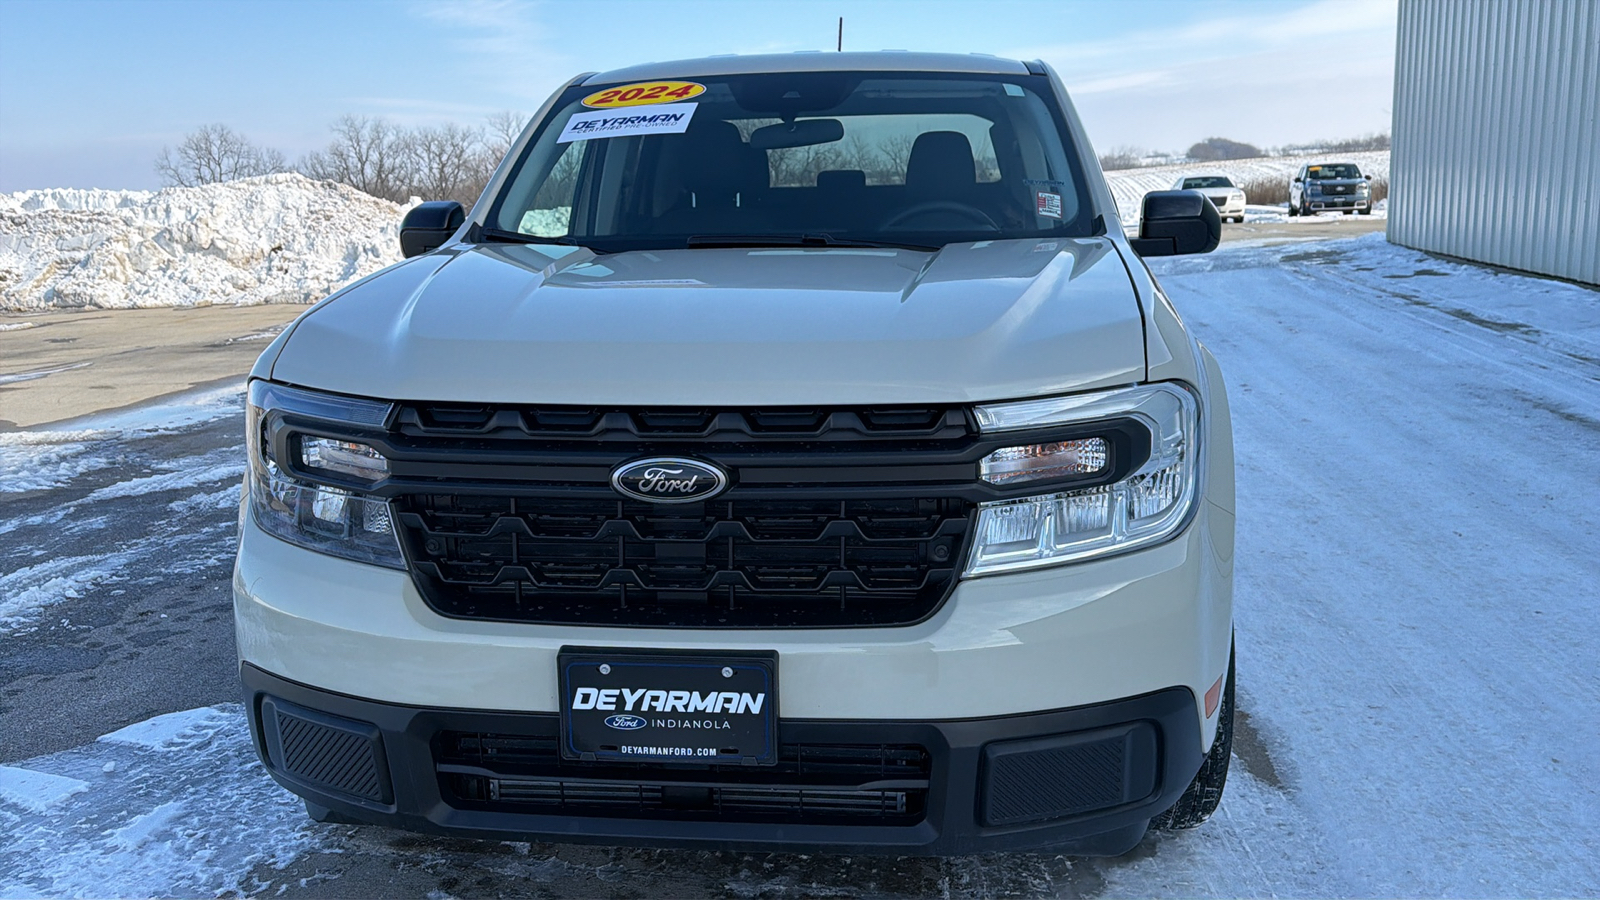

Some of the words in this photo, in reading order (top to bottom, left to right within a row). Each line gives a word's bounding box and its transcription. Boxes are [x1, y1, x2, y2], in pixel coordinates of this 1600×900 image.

[591, 84, 696, 105] 2024
[571, 113, 686, 131] DEYARMAN
[576, 125, 622, 134] CERTIFIED
[624, 121, 678, 129] PRE-OWNED
[638, 467, 698, 493] Ford
[572, 687, 765, 714] DEYARMAN
[612, 715, 639, 728] Ford
[651, 719, 731, 730] INDIANOLA
[621, 745, 717, 757] DEYARMANFORD.COM
